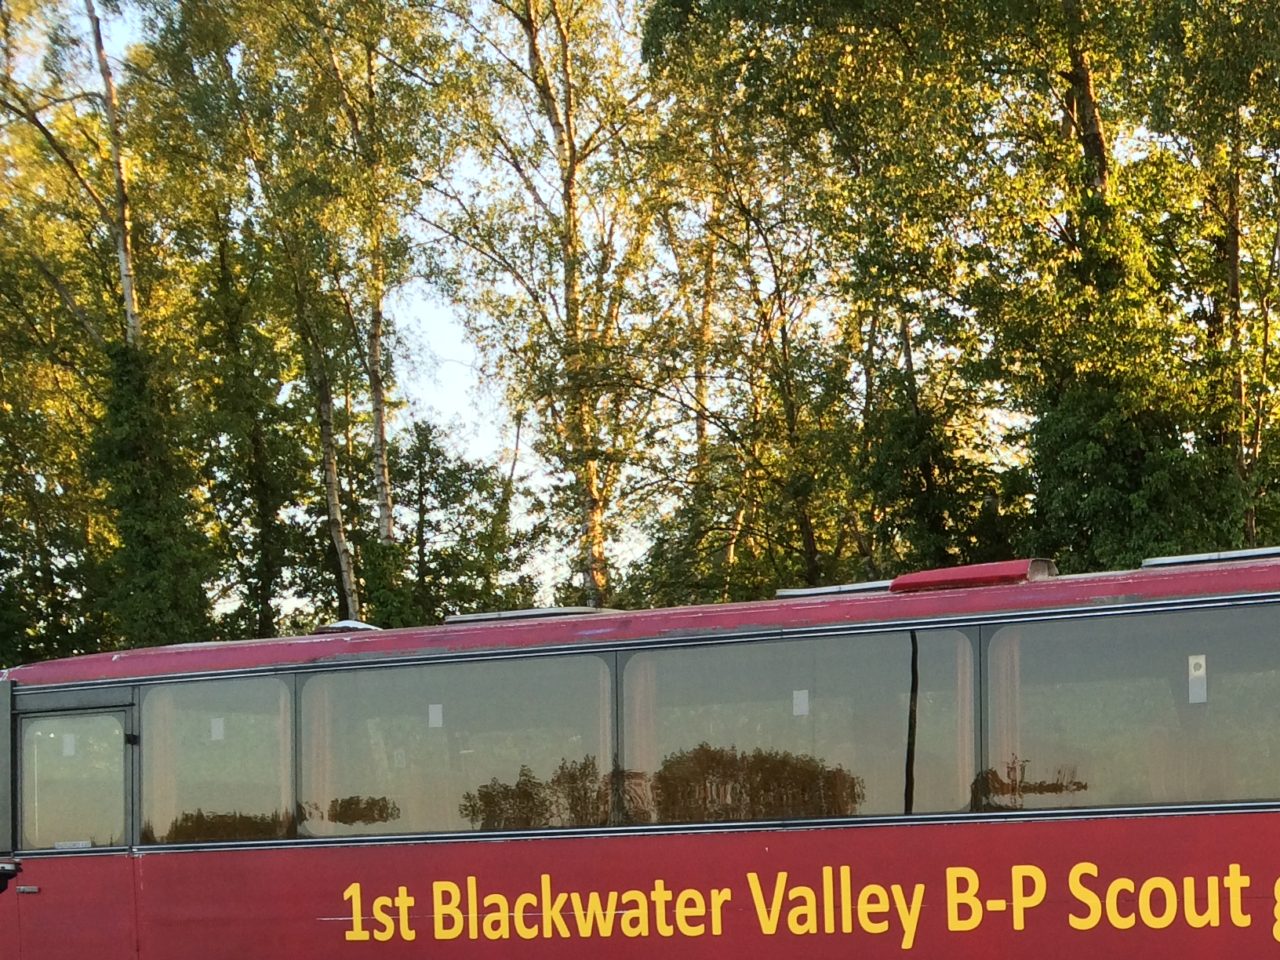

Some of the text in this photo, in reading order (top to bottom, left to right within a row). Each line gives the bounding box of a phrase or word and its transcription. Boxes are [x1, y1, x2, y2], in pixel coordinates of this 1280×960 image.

[343, 883, 416, 942] 1st
[432, 873, 732, 941] Blackwater
[747, 865, 925, 950] Valley
[945, 865, 1048, 933] B-P
[1067, 861, 1253, 931] Scout
